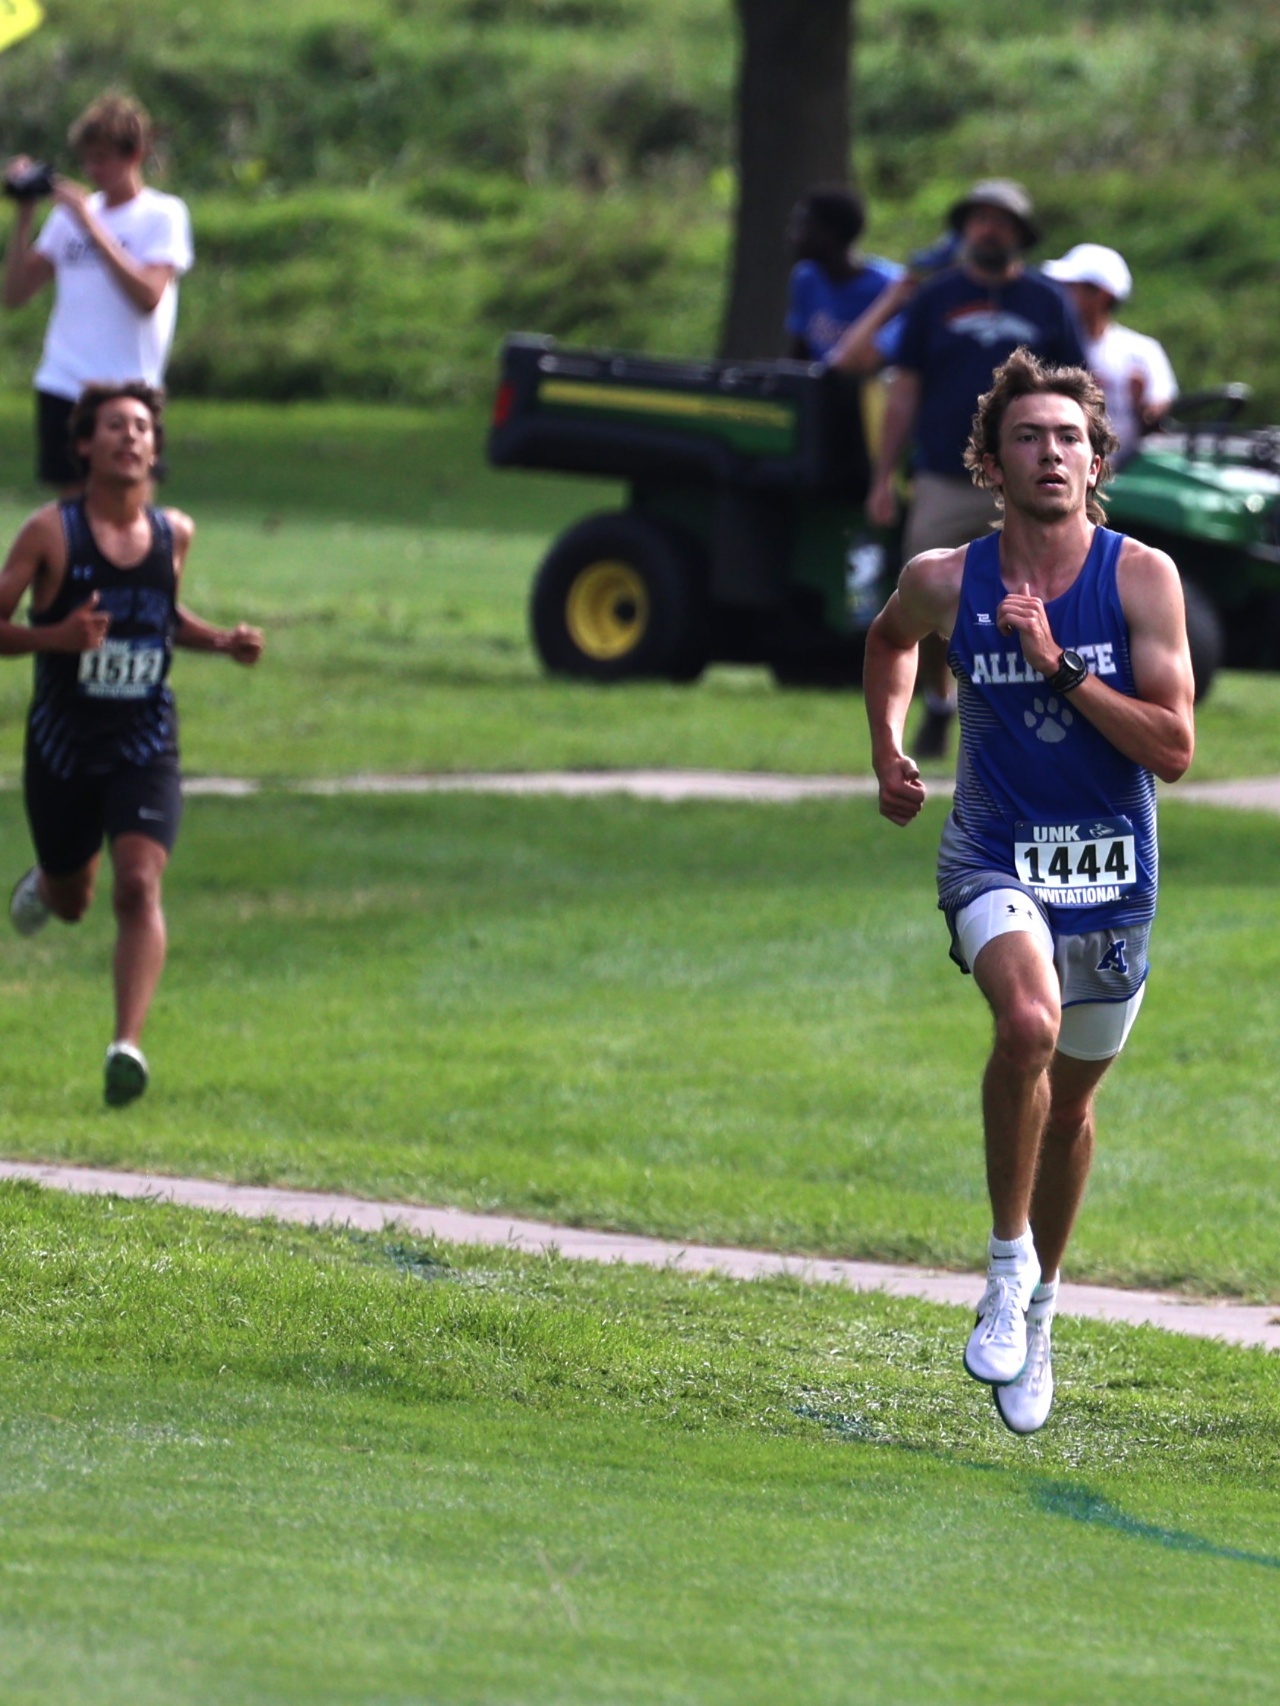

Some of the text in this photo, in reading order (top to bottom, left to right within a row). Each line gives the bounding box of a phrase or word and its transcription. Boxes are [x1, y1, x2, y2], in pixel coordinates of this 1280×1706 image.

[971, 642, 1117, 684] ALLICE
[1033, 825, 1081, 843] UNK
[1023, 840, 1129, 885] 1444
[1034, 885, 1122, 904] INVITATIONAL
[1095, 939, 1129, 975] A
